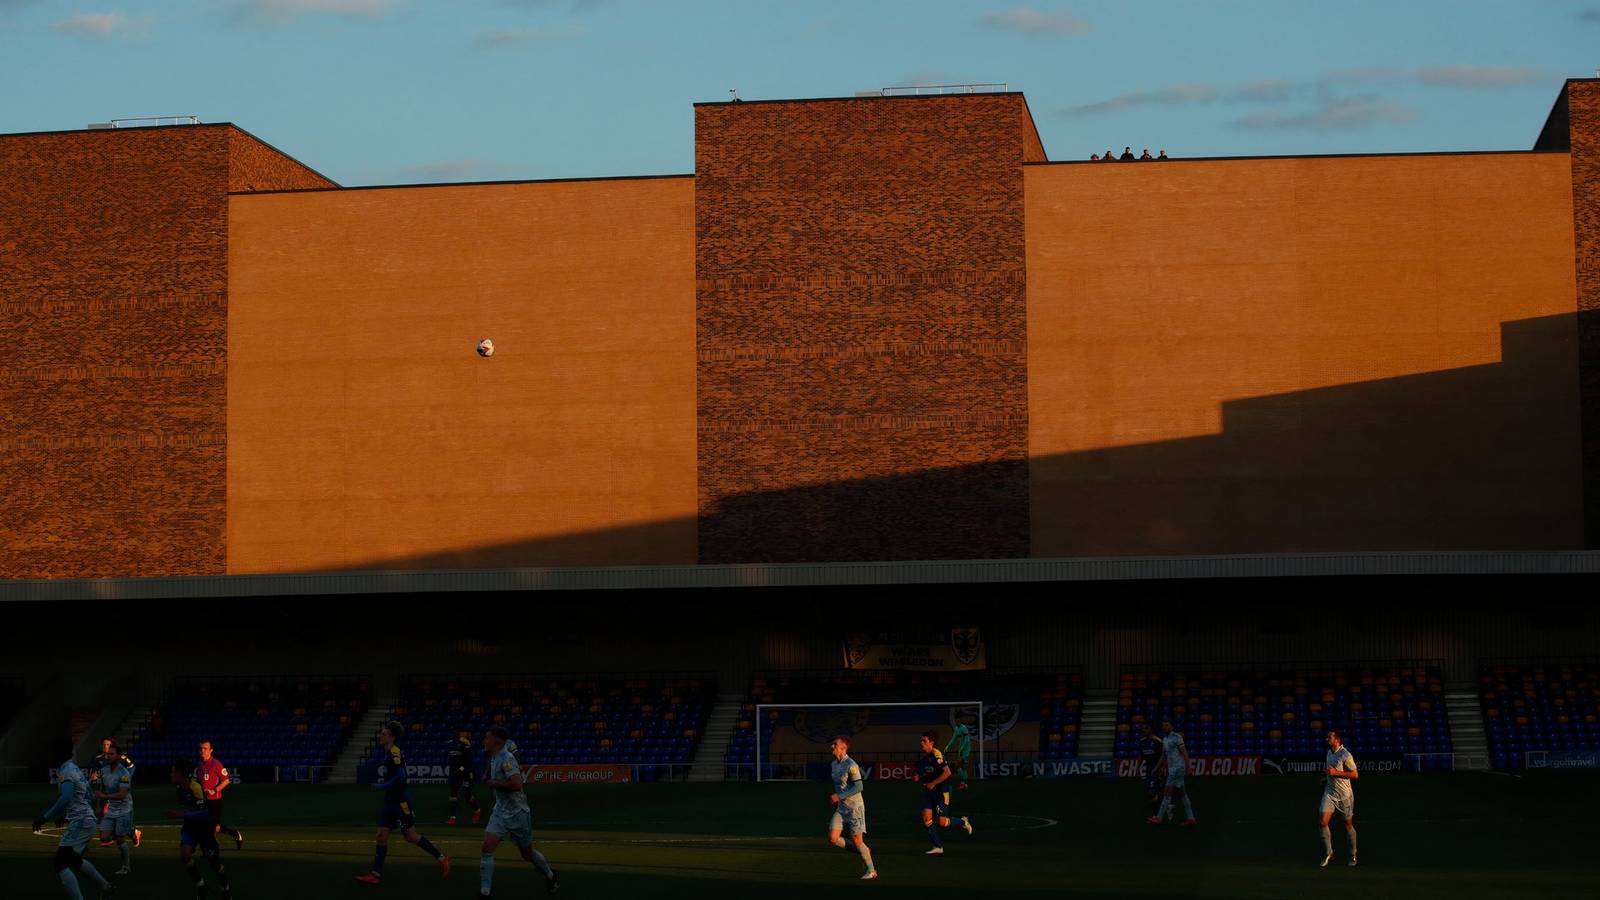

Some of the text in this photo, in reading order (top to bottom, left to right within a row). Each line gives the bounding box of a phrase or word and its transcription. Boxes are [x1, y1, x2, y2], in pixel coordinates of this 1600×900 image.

[879, 763, 913, 780] bet
[978, 760, 1112, 776] RESTN WASTE
[1118, 758, 1258, 777] CHEED.CO.UK
